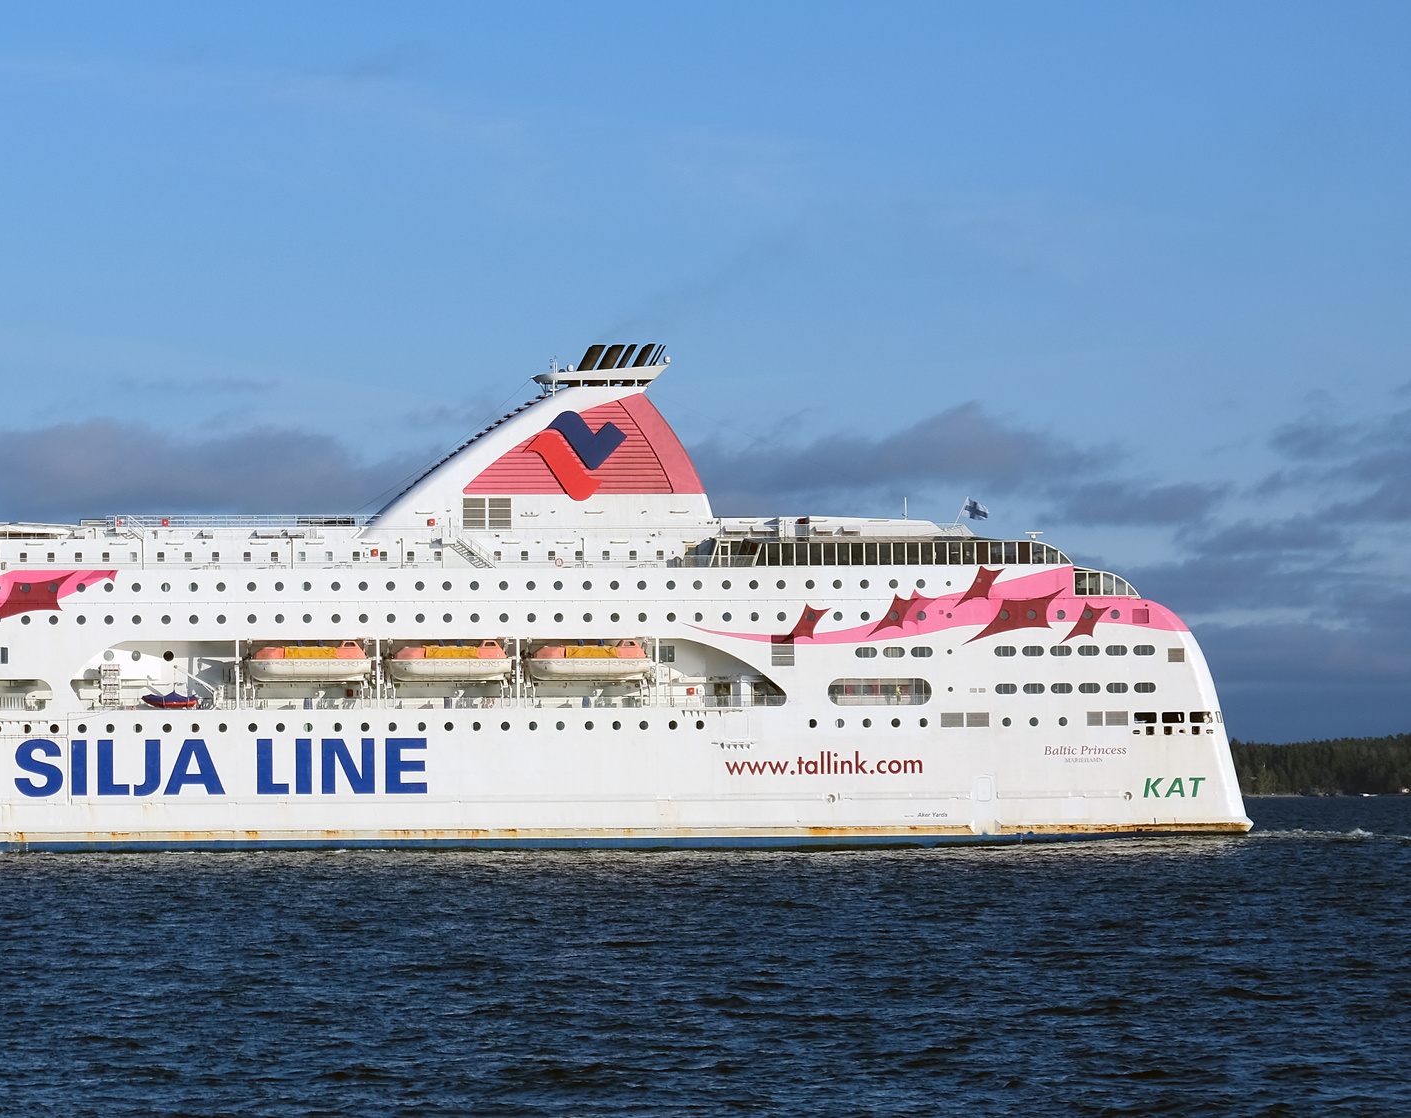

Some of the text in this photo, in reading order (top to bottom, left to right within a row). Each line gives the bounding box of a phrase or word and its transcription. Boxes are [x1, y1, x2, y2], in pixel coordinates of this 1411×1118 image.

[1044, 745, 1127, 756] Baltic Princess
[14, 737, 428, 797] SILJA LINE
[725, 751, 923, 775] www.tallink.com
[1143, 777, 1206, 798] KAT
